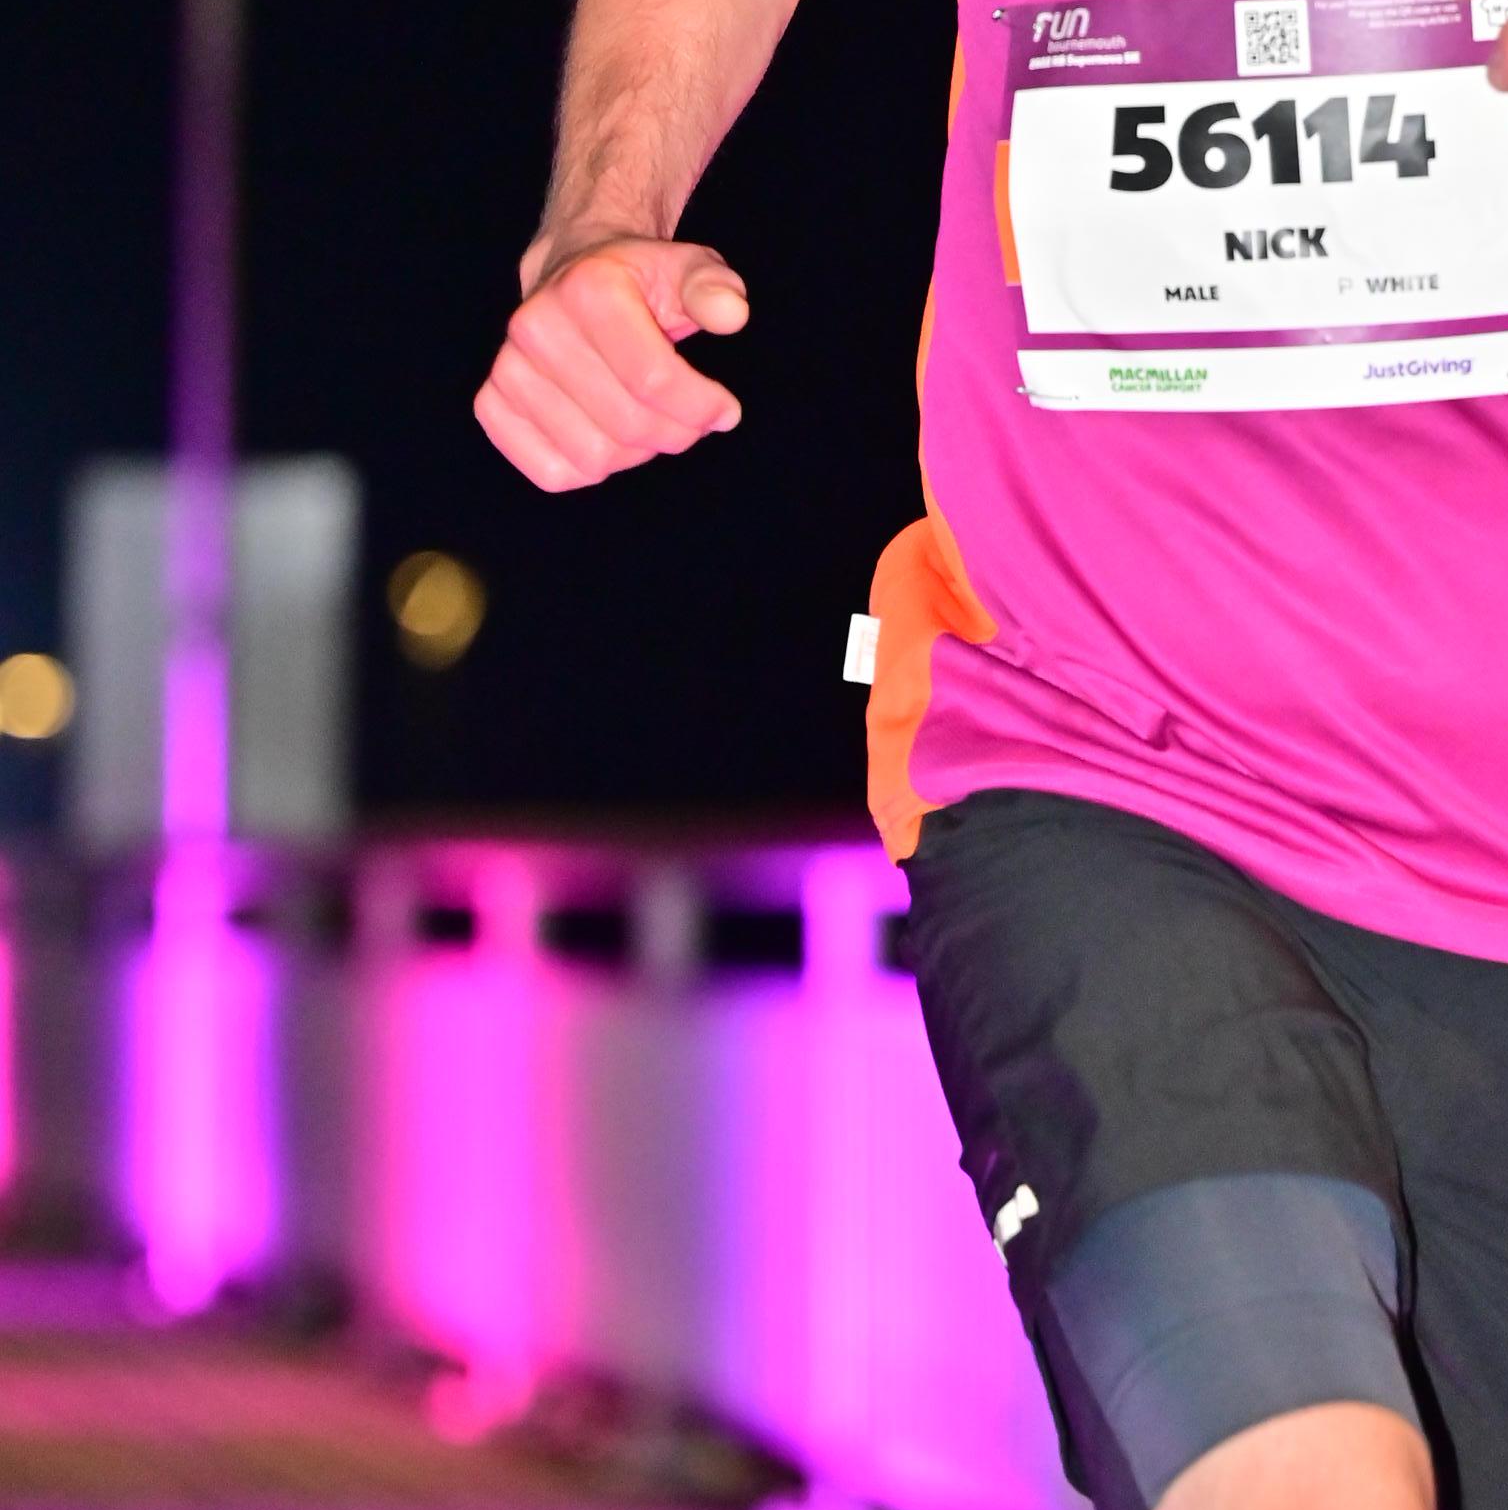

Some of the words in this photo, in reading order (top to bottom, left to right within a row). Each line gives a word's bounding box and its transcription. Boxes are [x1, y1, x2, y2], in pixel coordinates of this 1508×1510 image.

[1032, 7, 1090, 43] run
[1110, 94, 1436, 192] 56114
[1224, 226, 1329, 261] NICK
[1164, 285, 1220, 302] MALE
[1365, 273, 1440, 295] WHITE
[1109, 368, 1208, 382] MACMILLAN
[1363, 356, 1473, 380] JustGiving
